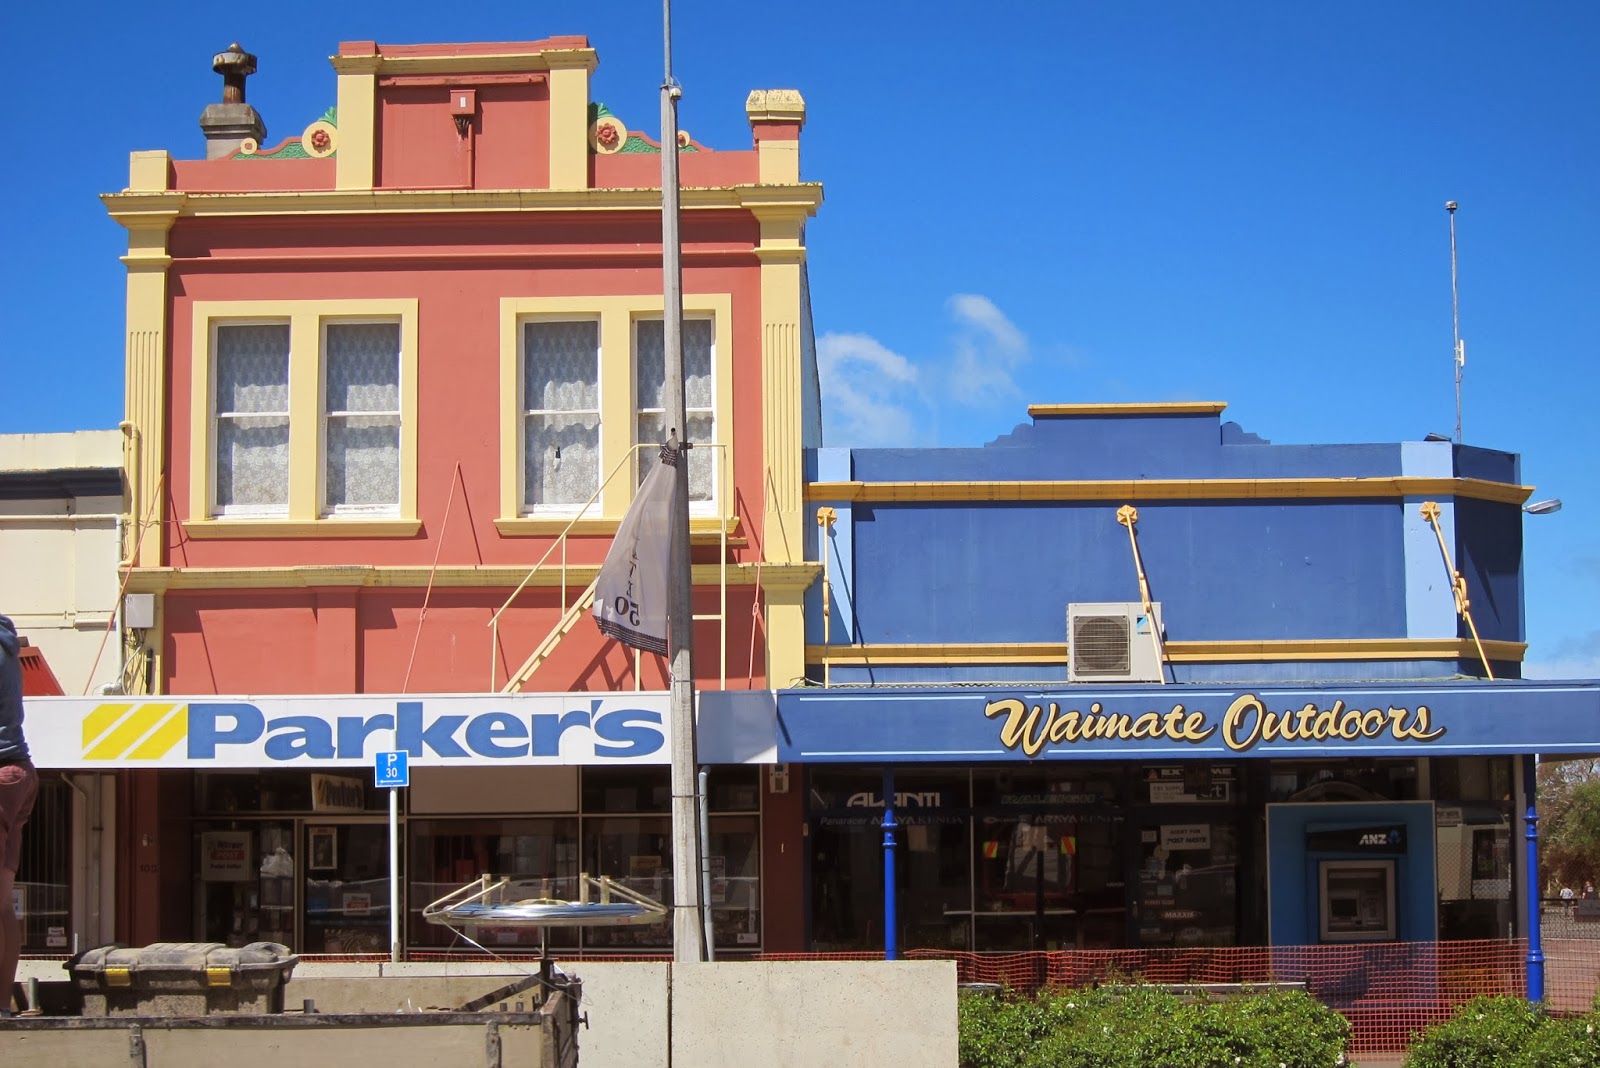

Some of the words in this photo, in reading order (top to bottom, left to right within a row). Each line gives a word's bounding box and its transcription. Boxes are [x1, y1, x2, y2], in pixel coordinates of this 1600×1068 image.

[188, 699, 664, 761] Parker's
[984, 699, 1216, 757] Waimate
[1221, 694, 1446, 752] Outdoors
[387, 753, 398, 767] P
[385, 767, 398, 778] 30
[820, 816, 867, 826] Panaracer
[870, 816, 916, 826] AAYA
[1034, 814, 1078, 824] ARAYA
[1358, 833, 1388, 845] ANZ
